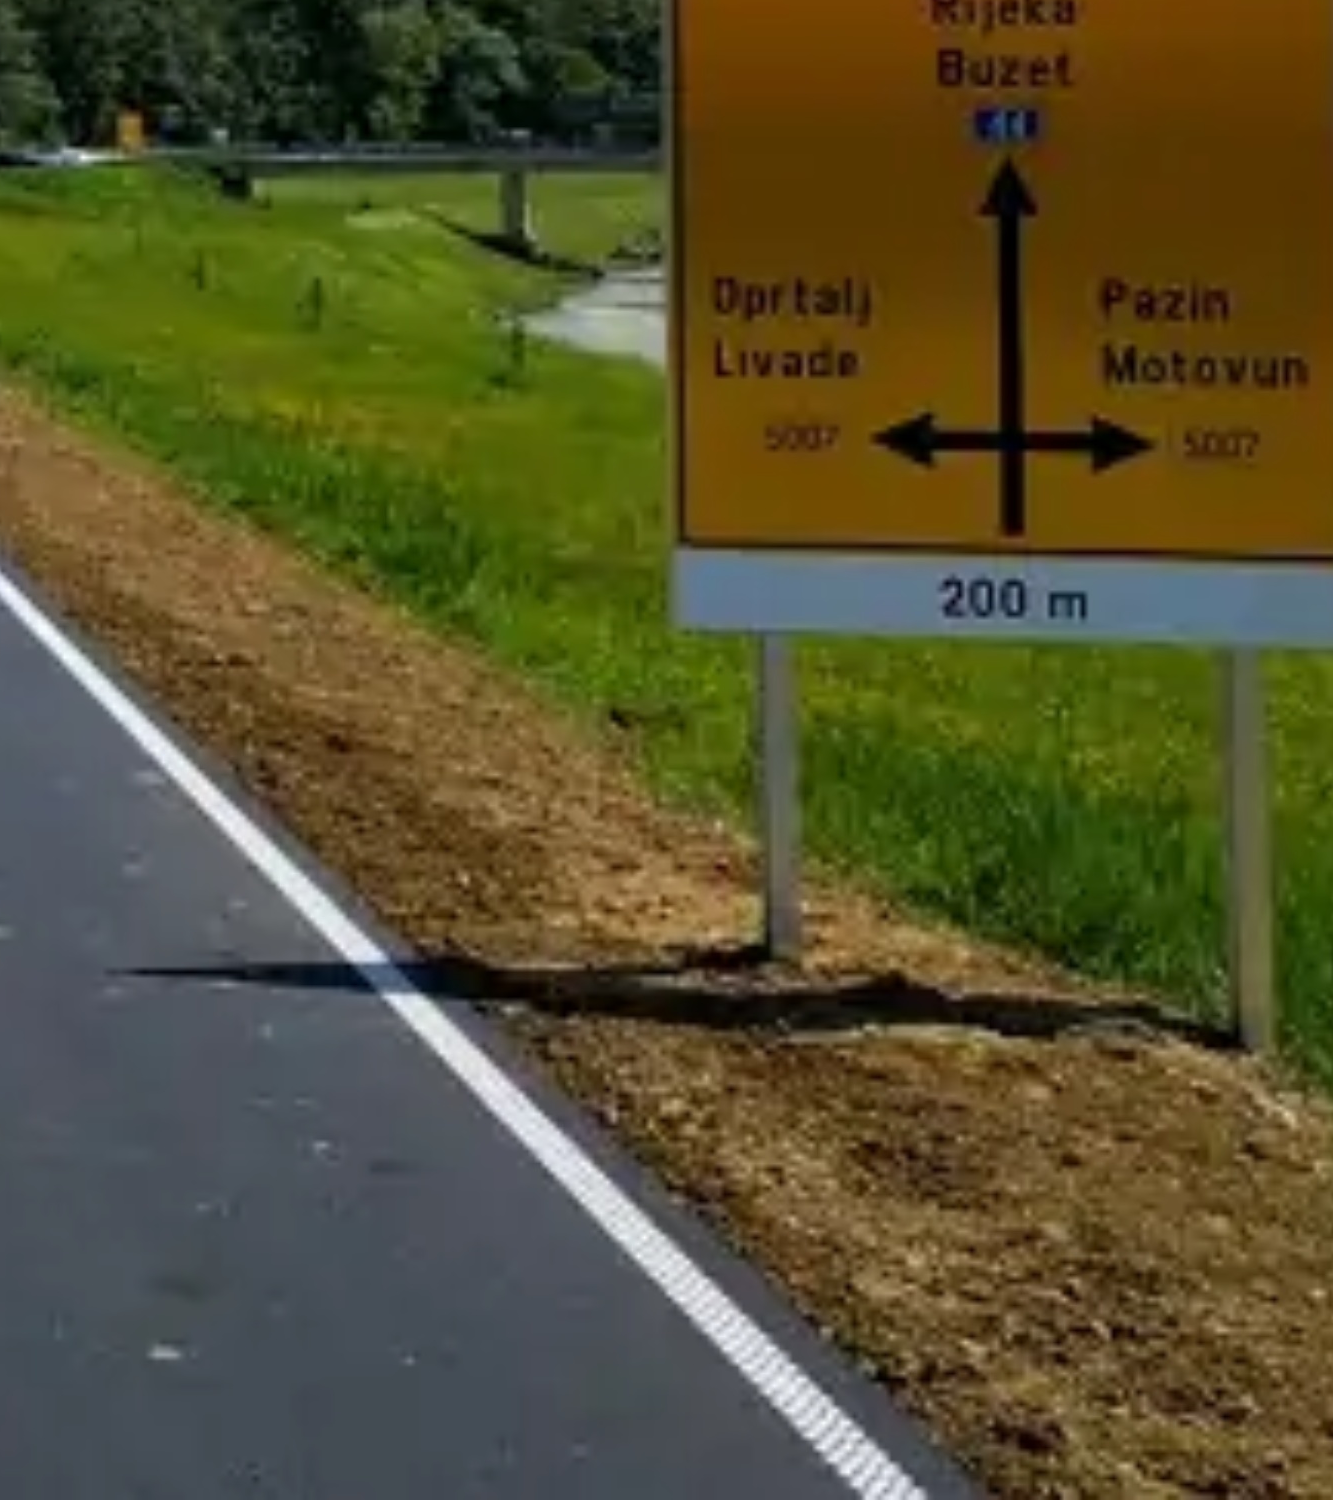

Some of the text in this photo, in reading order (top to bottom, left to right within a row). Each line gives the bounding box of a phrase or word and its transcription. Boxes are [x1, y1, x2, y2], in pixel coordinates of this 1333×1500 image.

[937, 47, 1074, 88] Buzet
[713, 274, 872, 328] Oprtalj
[1100, 276, 1230, 322] Pazin
[714, 337, 860, 378] Livade
[1102, 343, 1310, 389] Motovun
[939, 577, 1089, 619] 200 m
